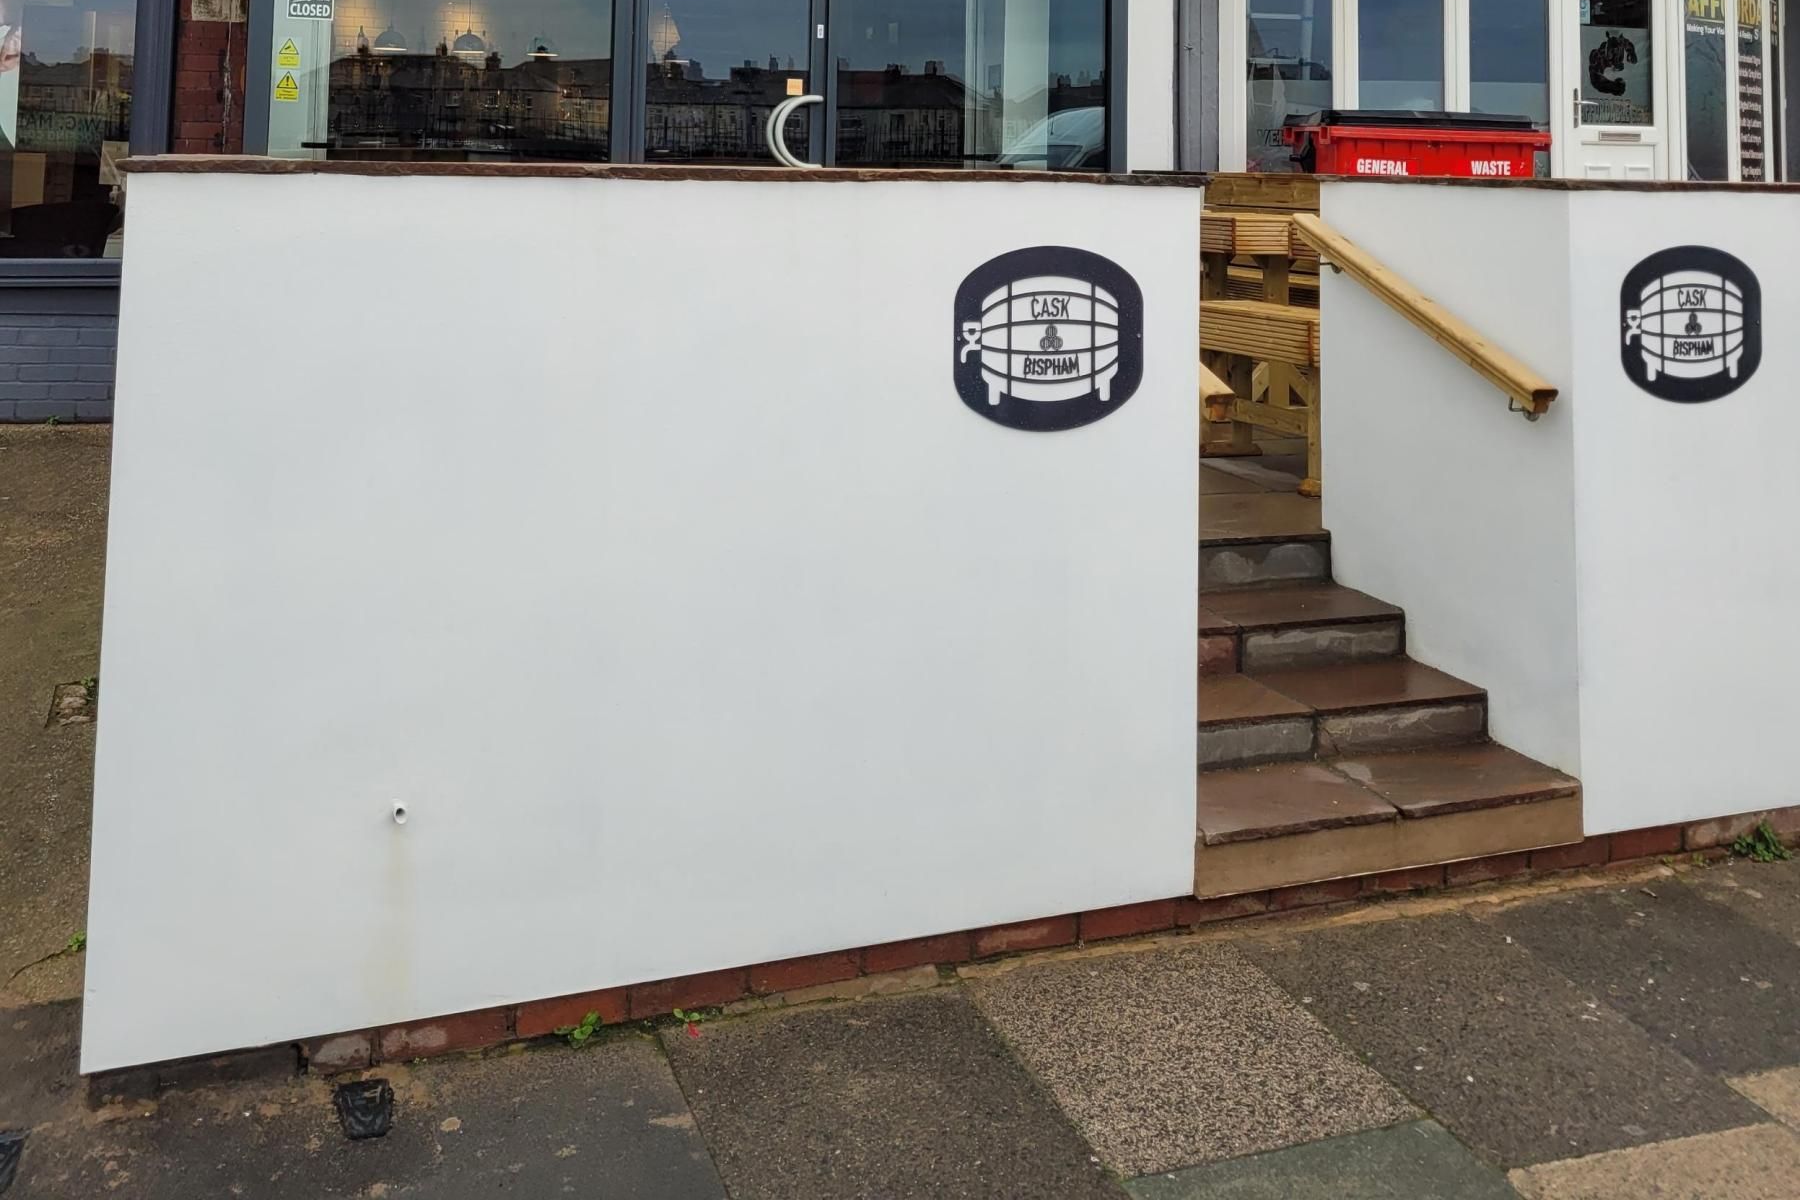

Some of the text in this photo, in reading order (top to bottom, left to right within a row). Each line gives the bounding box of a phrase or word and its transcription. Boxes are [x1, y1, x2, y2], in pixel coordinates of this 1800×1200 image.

[289, 3, 331, 17] CLOSED
[1356, 158, 1511, 176] GENERAL WASTE
[1031, 296, 1070, 320] CASK
[1677, 288, 1707, 309] CASK
[1673, 338, 1715, 358] BISPHAM
[1023, 354, 1080, 378] BISPHAM
